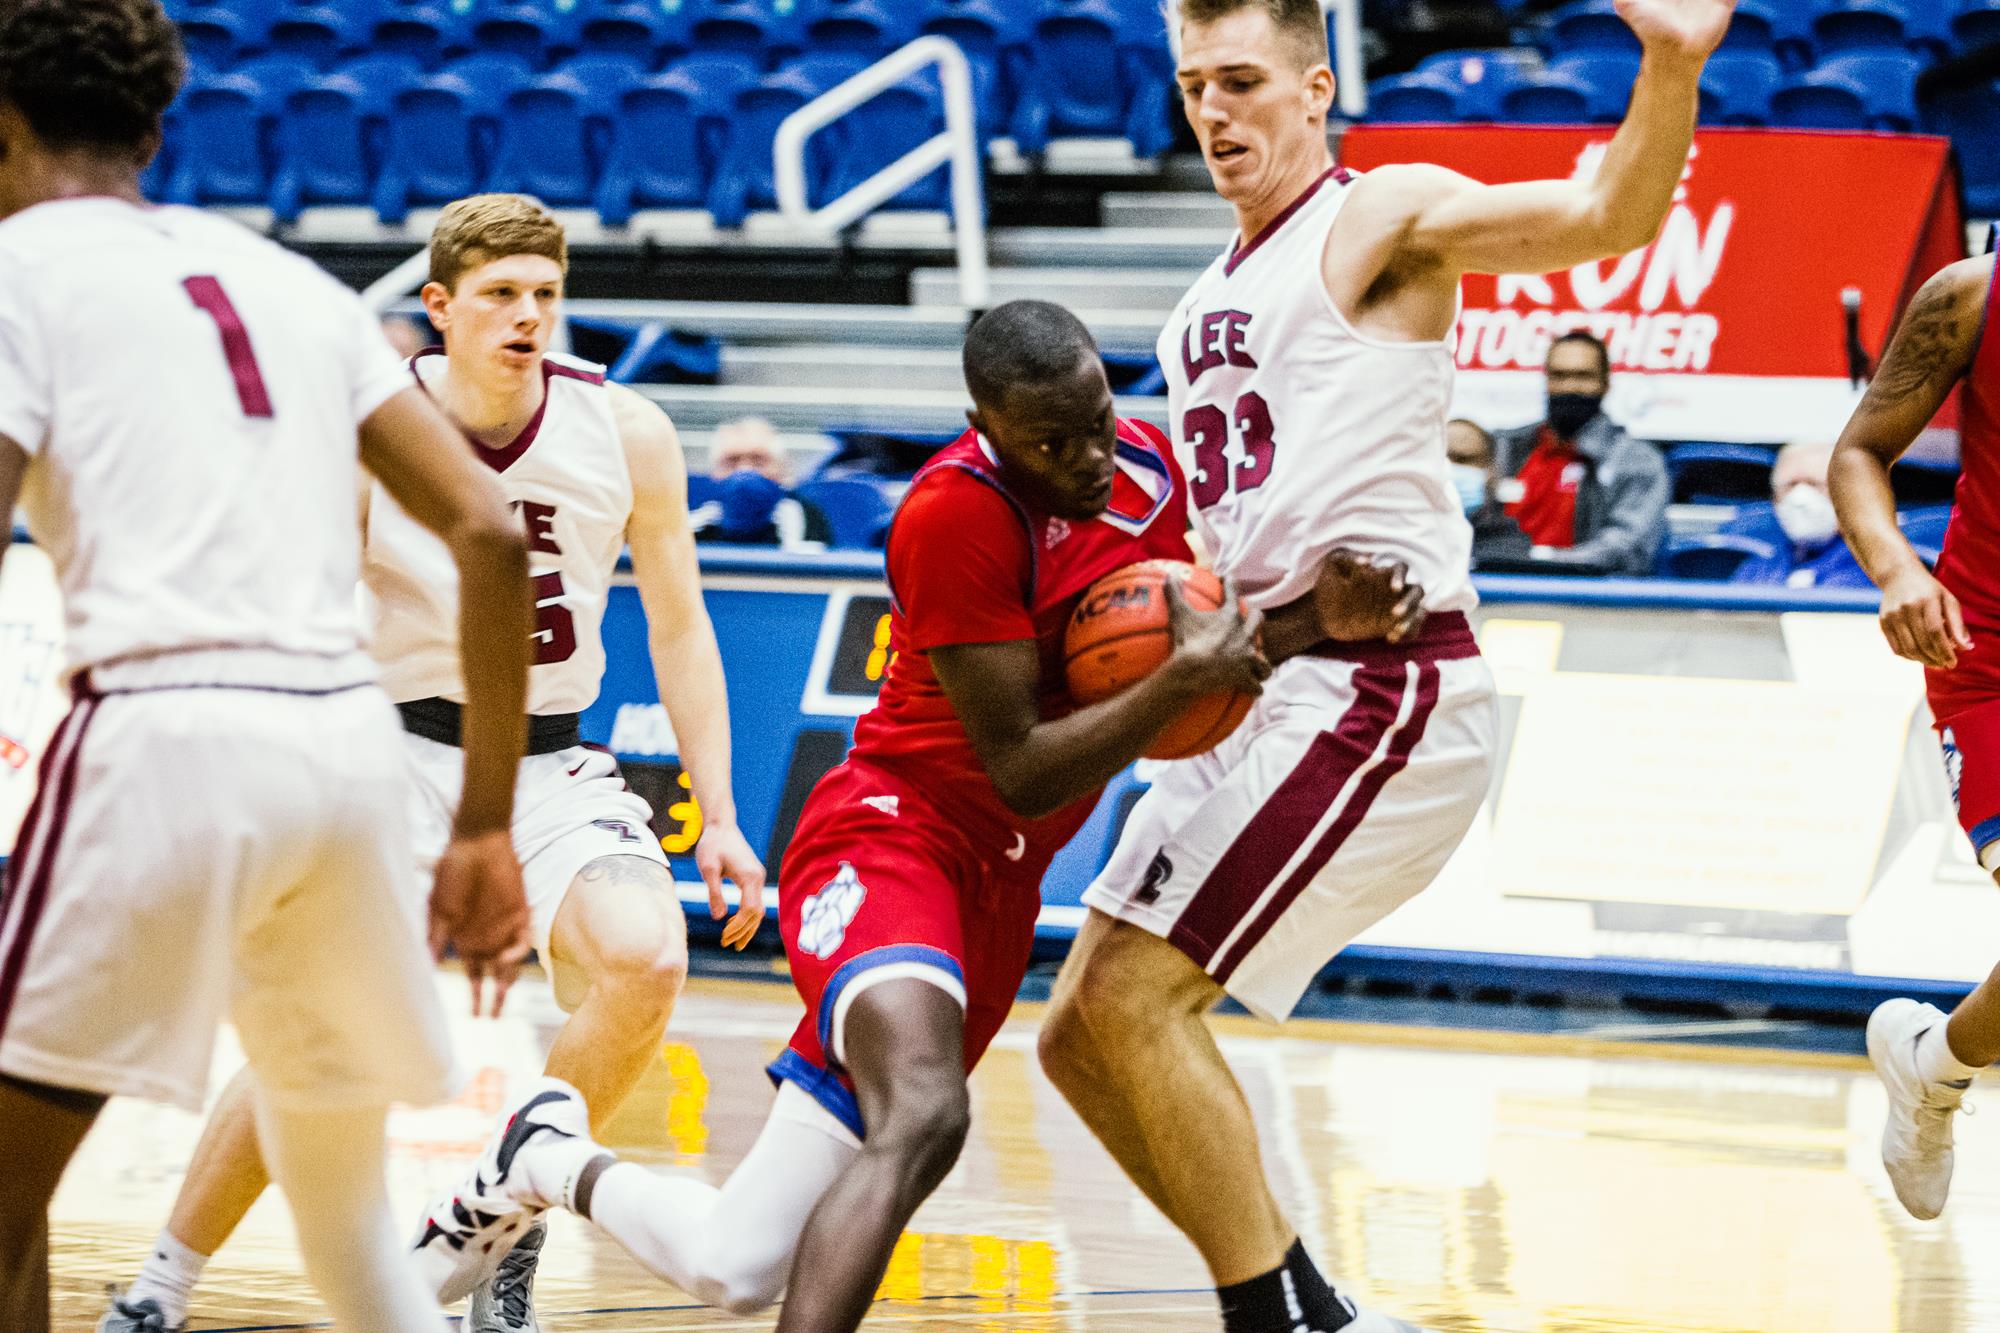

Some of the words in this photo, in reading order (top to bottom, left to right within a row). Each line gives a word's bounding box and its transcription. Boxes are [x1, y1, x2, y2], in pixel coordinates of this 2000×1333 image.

[181, 274, 274, 419] 1
[1181, 309, 1258, 386] LEE
[1183, 391, 1276, 511] 33
